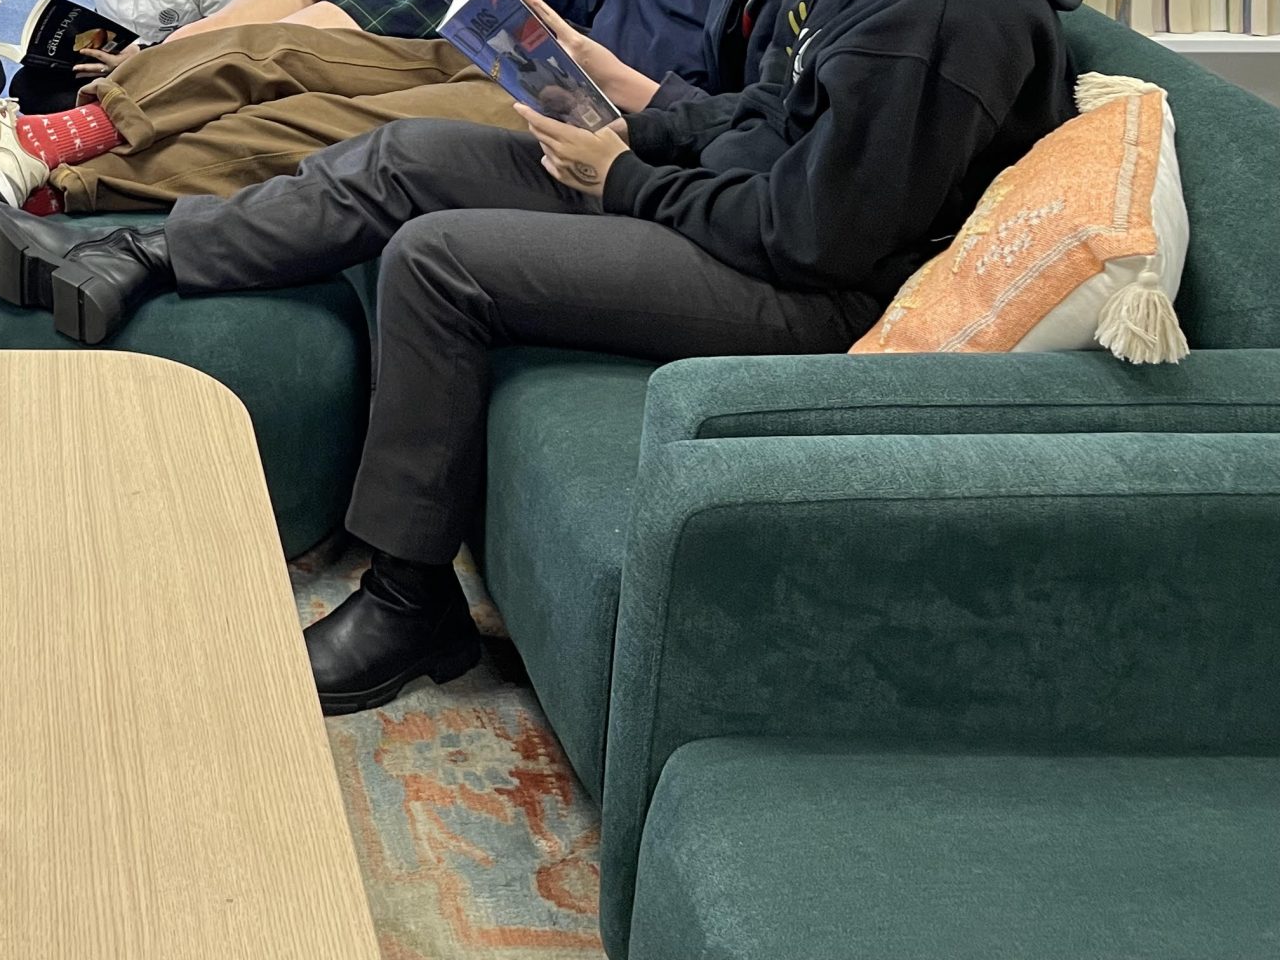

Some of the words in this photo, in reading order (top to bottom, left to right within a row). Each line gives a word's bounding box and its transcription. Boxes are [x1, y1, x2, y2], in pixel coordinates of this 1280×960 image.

[47, 28, 66, 56] GREEK
[60, 8, 82, 28] PLAYS
[453, 7, 499, 55] DAGS
[22, 124, 46, 161] FUCK
[62, 114, 84, 152] FUCK
